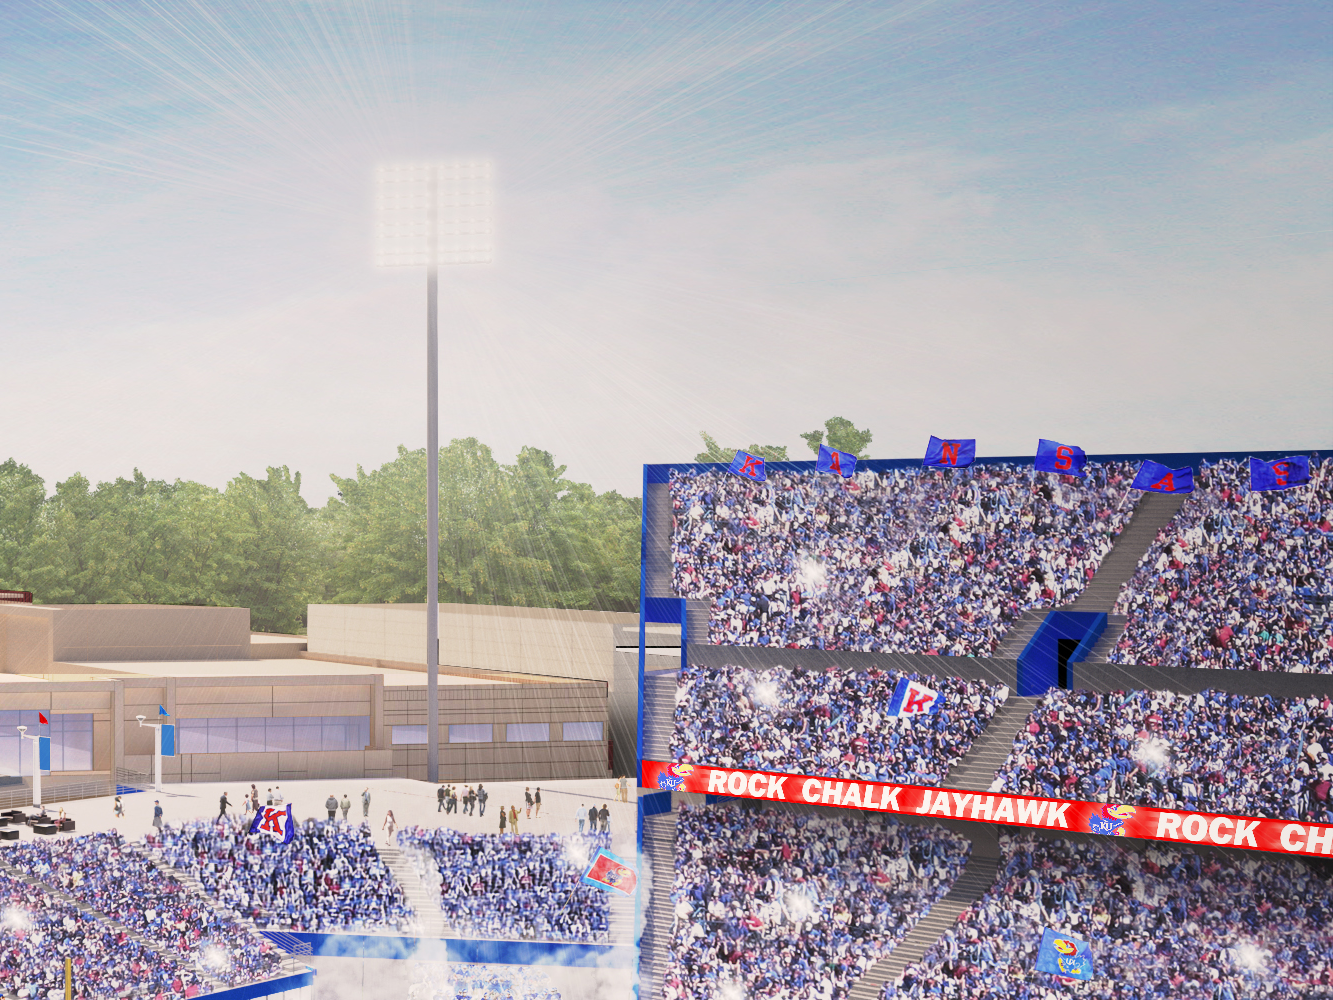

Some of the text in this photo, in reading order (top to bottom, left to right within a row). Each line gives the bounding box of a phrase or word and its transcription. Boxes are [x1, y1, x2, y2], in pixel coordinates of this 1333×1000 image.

[738, 455, 763, 477] K
[939, 442, 962, 466] N
[1054, 446, 1074, 470] S
[903, 688, 934, 713] K
[707, 770, 1071, 829] ROCK CHALK JAYHAWK
[260, 807, 286, 836] K
[1155, 811, 1262, 848] ROCK
